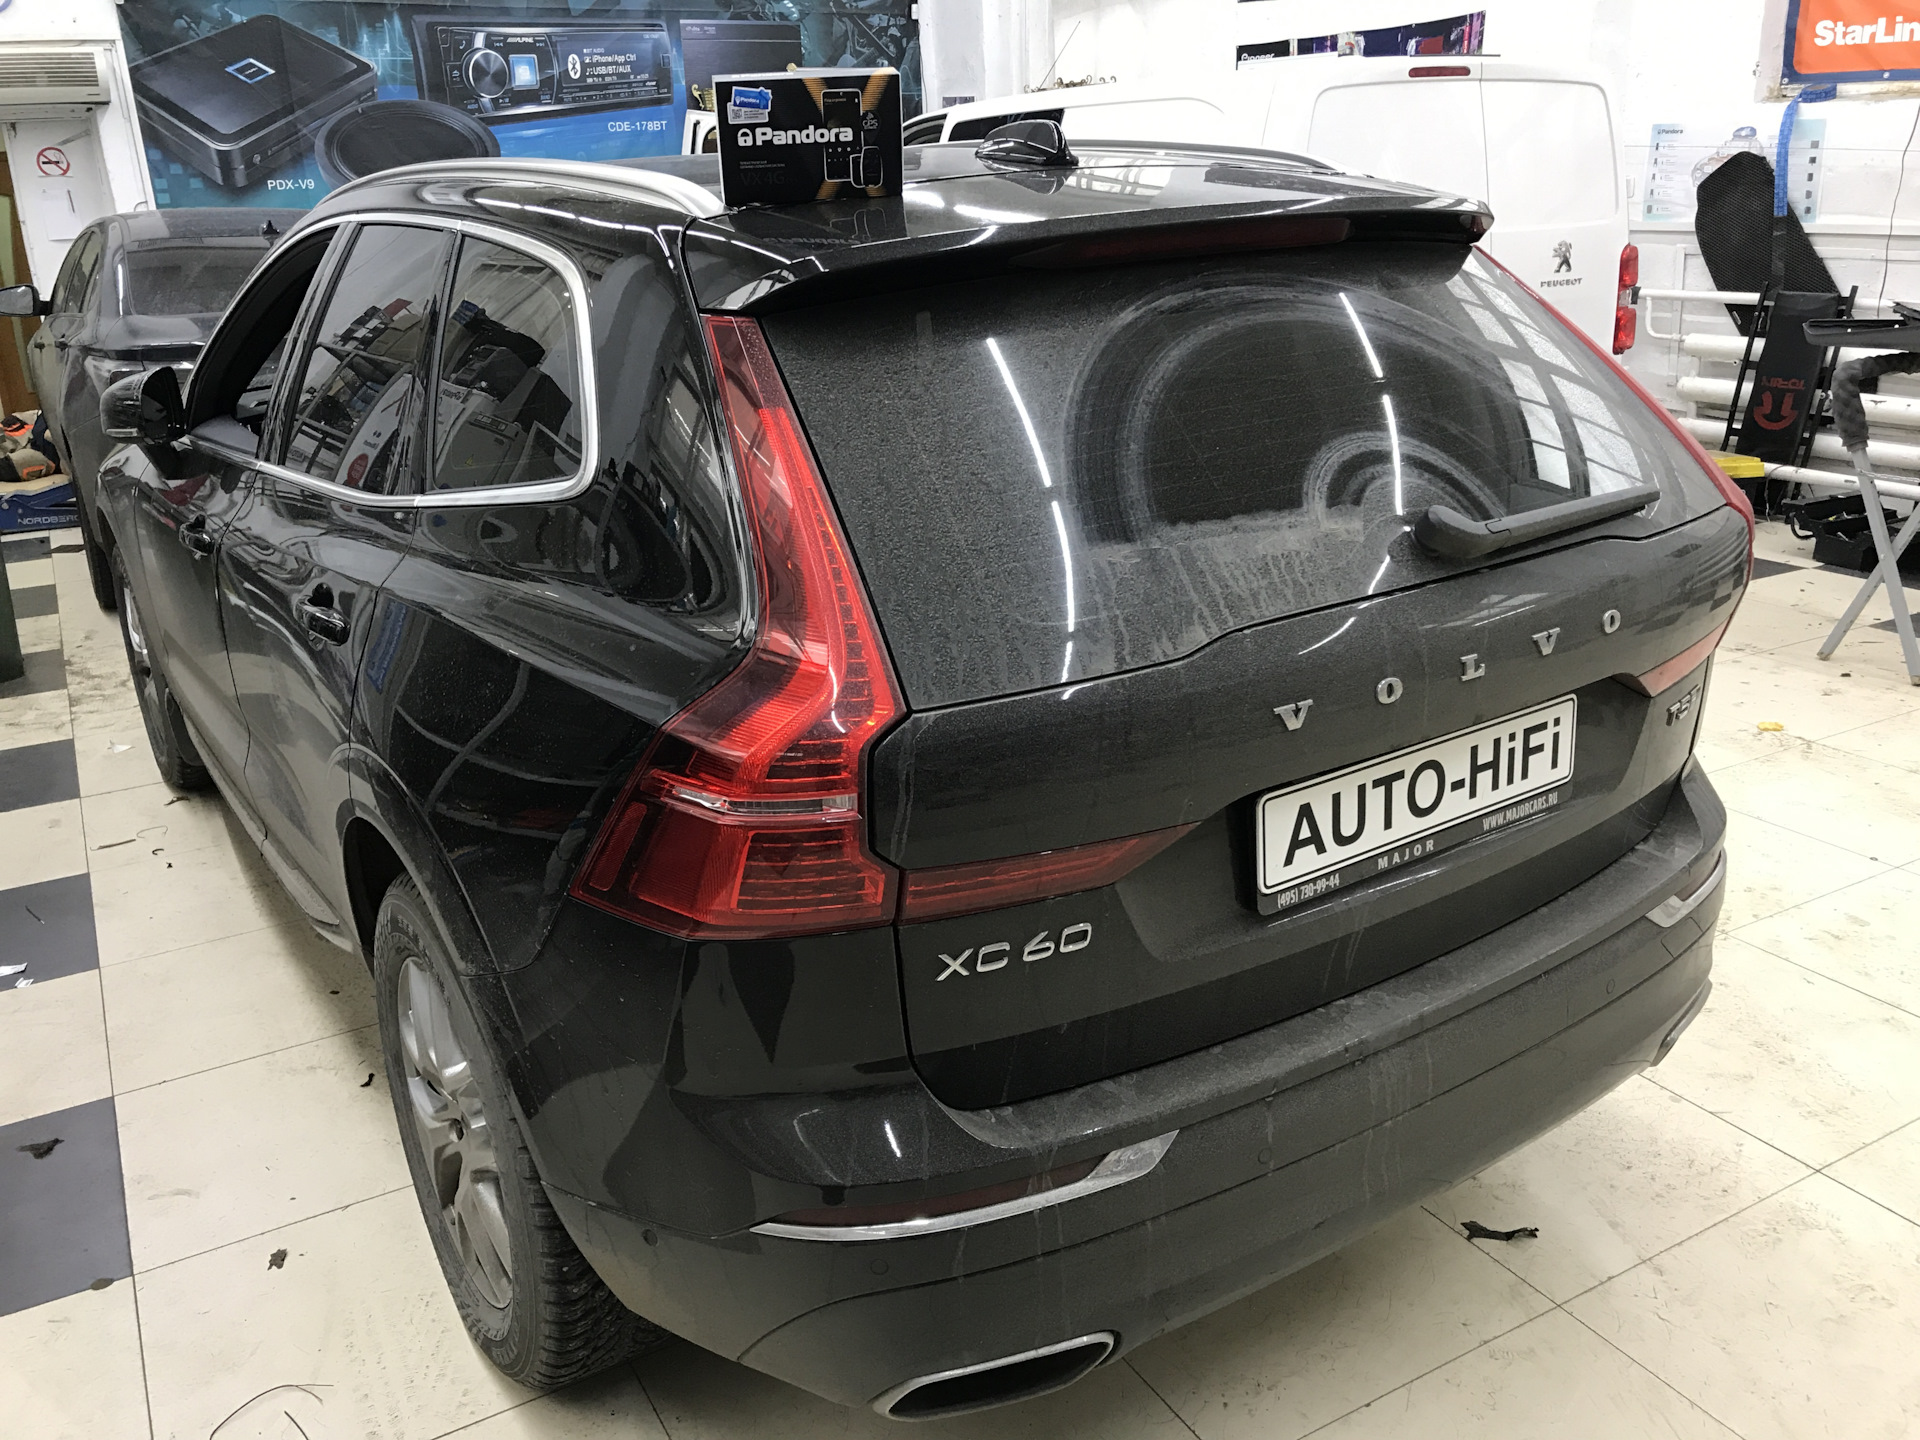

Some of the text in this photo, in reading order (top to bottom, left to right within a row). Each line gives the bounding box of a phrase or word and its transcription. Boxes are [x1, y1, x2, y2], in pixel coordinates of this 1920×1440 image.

[592, 54, 625, 64] iPhone/App
[593, 64, 632, 75] USB/BT/AUX
[607, 120, 668, 132] CDE-178BT
[1661, 127, 1684, 135] Pandora
[755, 124, 853, 146] Pandora
[266, 178, 316, 191] PDX-V9
[1540, 277, 1583, 288] PEUGEOT
[1272, 608, 1622, 731] VOLVO
[1282, 716, 1561, 868] AUTO-HiFi
[1482, 791, 1559, 832] WWW.MAJORCARS.RU
[1377, 839, 1435, 871] MAJOR
[1277, 872, 1340, 909] (495) 730-99-44
